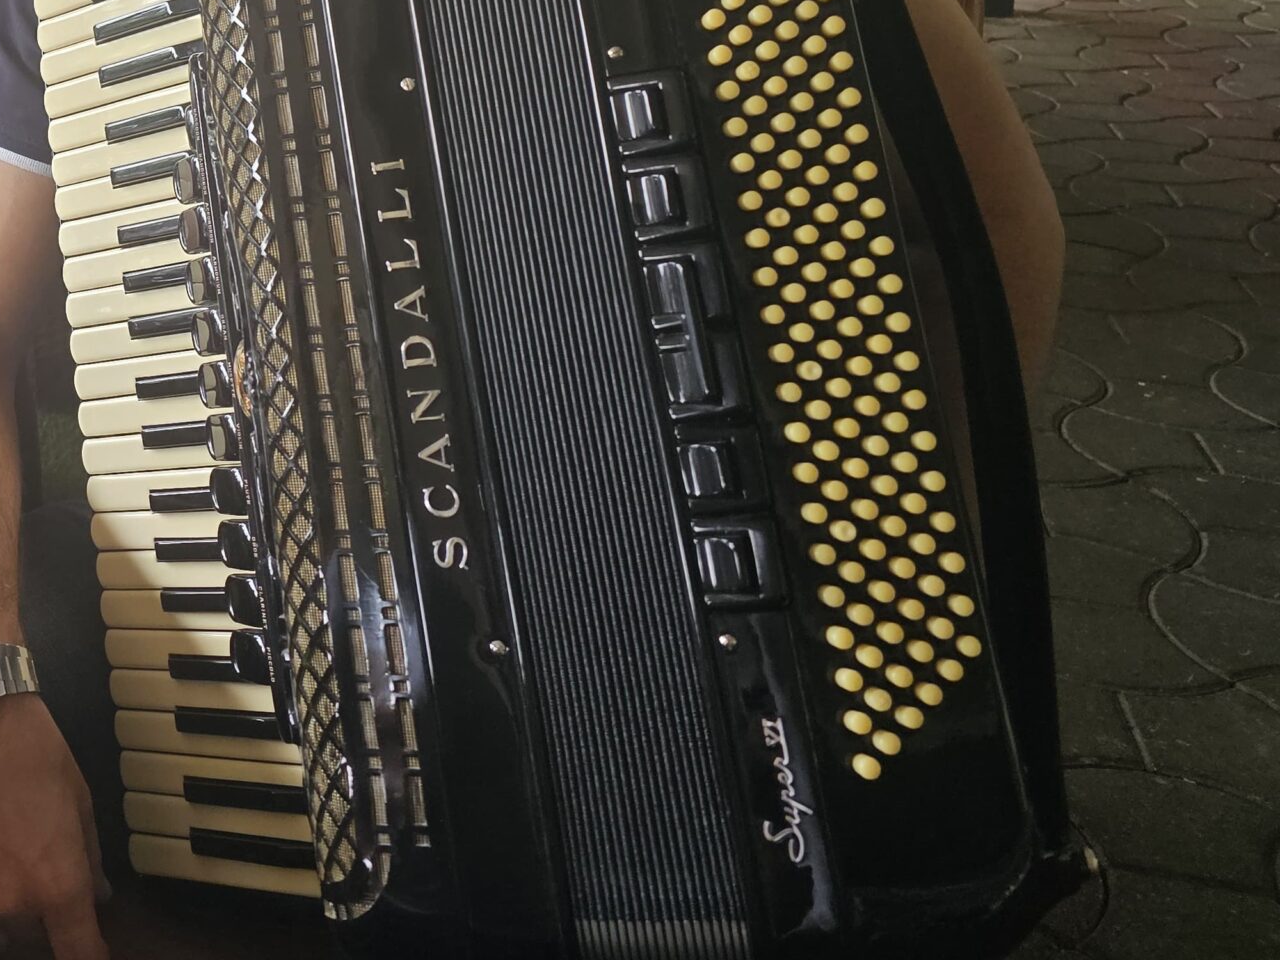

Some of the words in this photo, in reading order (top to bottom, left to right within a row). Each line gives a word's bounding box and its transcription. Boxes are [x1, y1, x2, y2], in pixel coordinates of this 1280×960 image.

[370, 157, 469, 570] SCANDALLI
[243, 479, 251, 505] FLUTE
[258, 586, 268, 630] CLARINET
[266, 647, 275, 683] PICCOLO
[763, 755, 814, 863] Super
